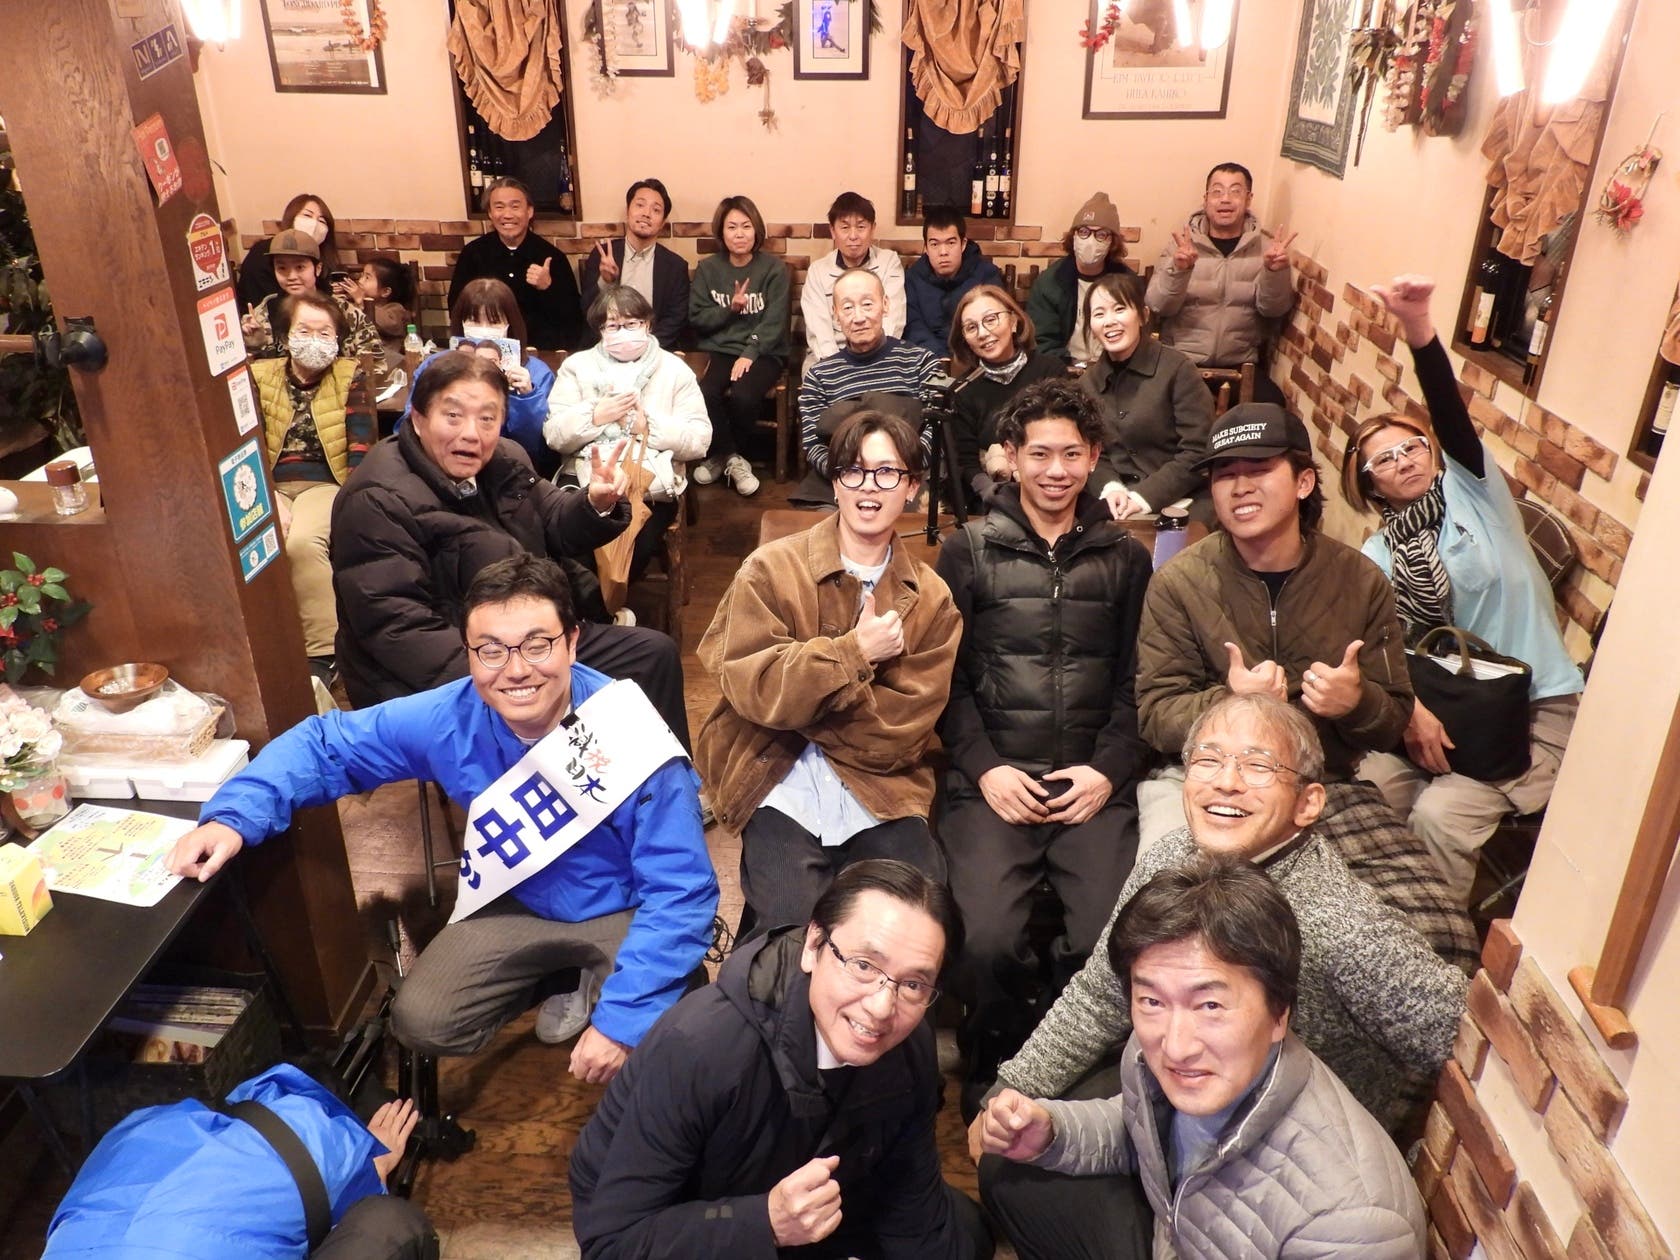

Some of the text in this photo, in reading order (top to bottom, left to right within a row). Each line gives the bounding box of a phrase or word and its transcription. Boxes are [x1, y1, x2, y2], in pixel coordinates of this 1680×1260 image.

[216, 340, 235, 355] PayPay
[1212, 429, 1229, 443] MAKE
[1213, 432, 1261, 449] GREAT AGAIN
